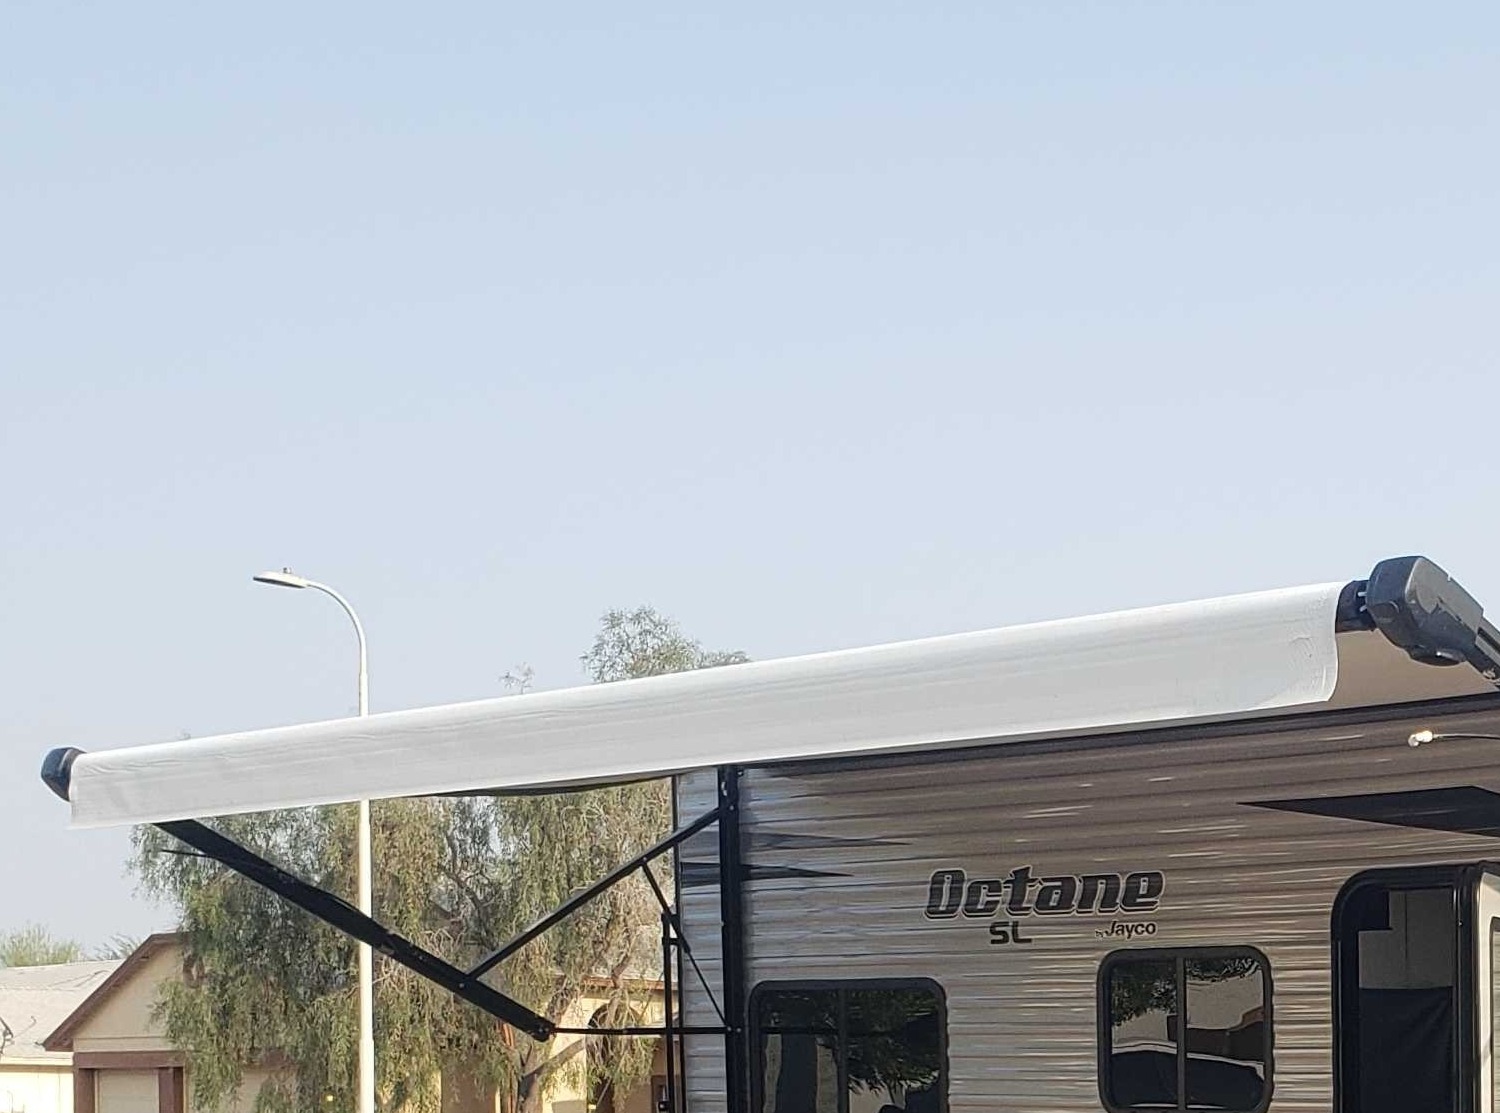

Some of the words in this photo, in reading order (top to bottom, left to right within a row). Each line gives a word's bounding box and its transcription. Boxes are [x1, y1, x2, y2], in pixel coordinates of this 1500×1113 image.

[924, 865, 1165, 920] Octane
[989, 921, 1033, 945] SL
[1104, 920, 1157, 940] Jayco
